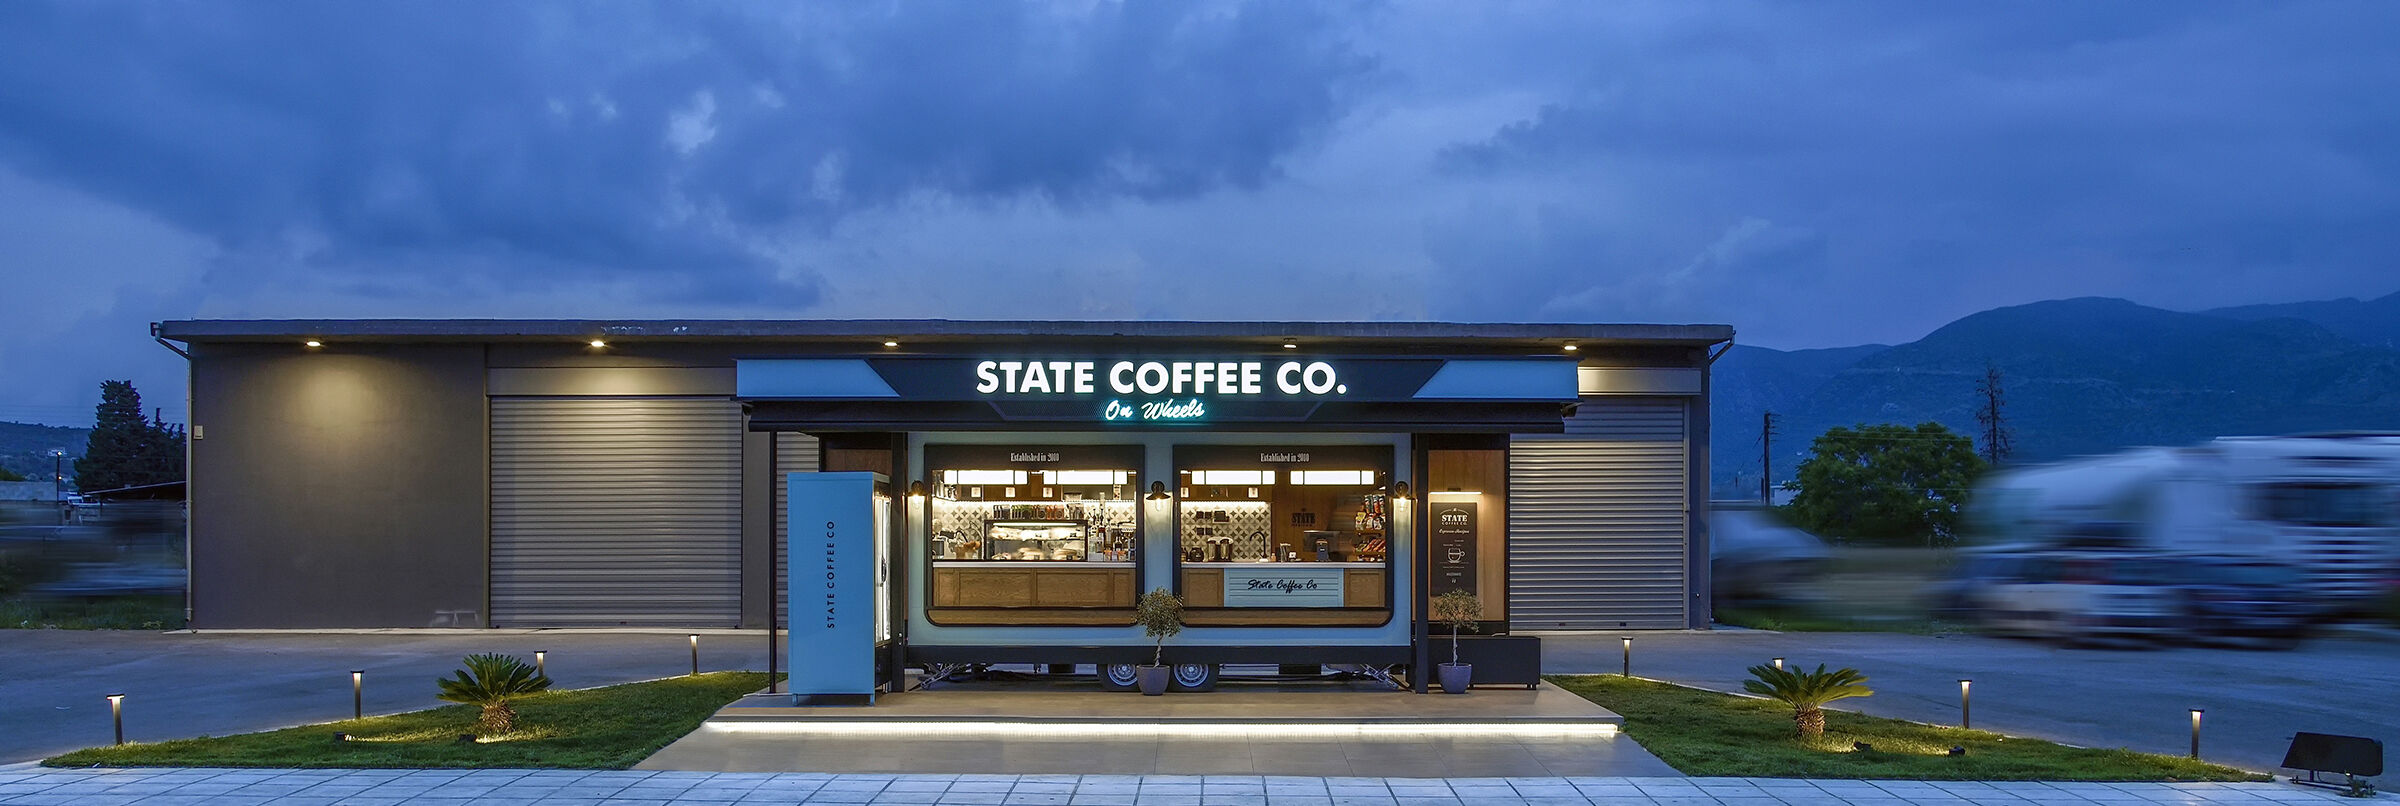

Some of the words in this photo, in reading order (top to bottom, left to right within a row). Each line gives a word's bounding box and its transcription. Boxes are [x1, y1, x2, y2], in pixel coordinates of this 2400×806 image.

[976, 360, 1094, 393] STATE
[1109, 360, 1262, 394] COFFEE
[1276, 360, 1347, 394] CO.
[1105, 399, 1133, 420] On
[1141, 398, 1205, 420] Wheels
[1010, 452, 1040, 462] Established
[1041, 452, 1047, 462] in
[1260, 452, 1290, 462] Established
[1291, 452, 1297, 462] in
[826, 521, 835, 539] CO
[826, 543, 835, 589] COFFEE
[1247, 579, 1274, 590] State
[1276, 579, 1303, 594] Coffee
[1306, 579, 1318, 589] Co
[826, 593, 835, 629] STATE
